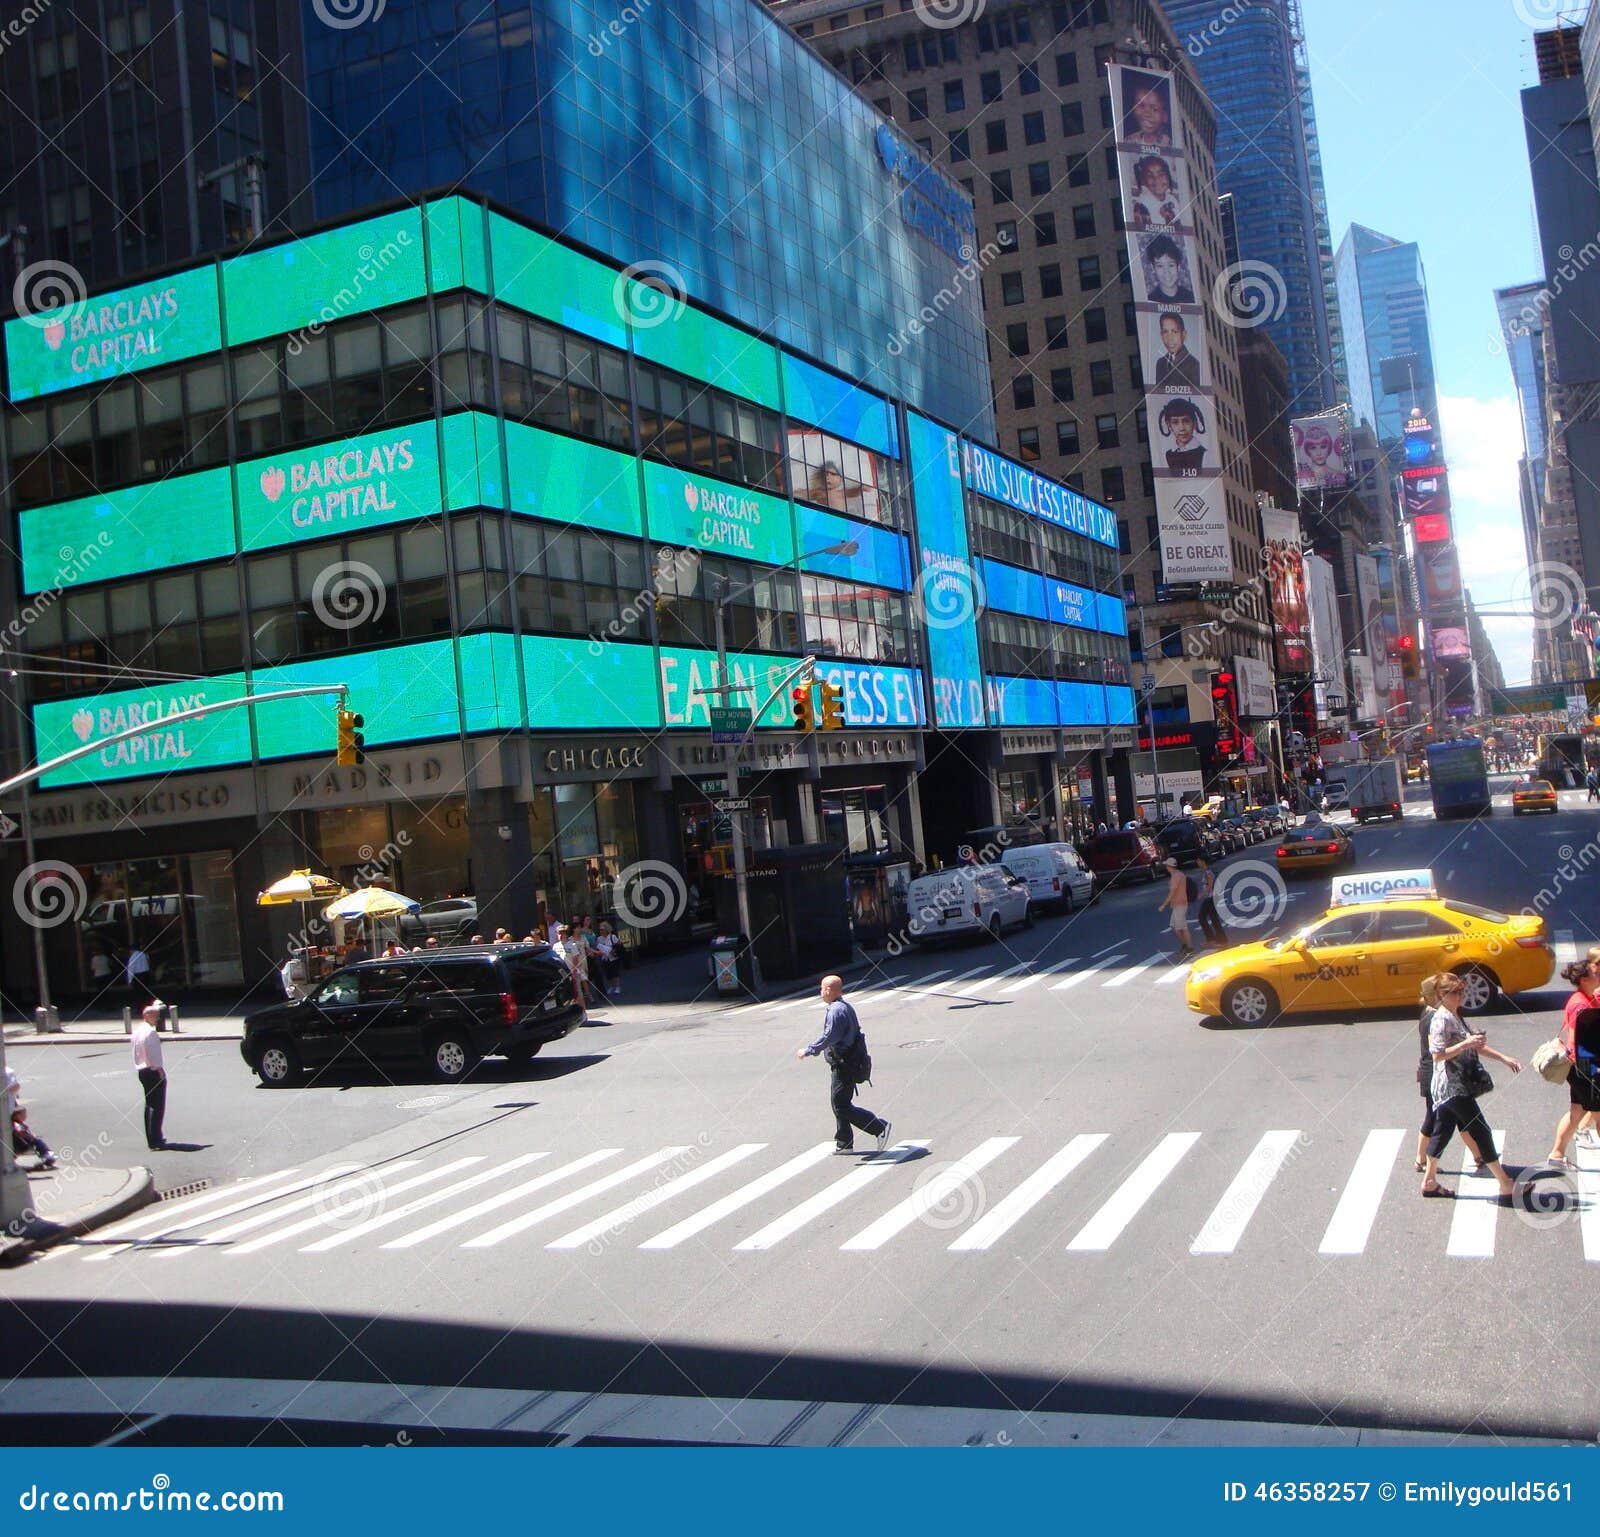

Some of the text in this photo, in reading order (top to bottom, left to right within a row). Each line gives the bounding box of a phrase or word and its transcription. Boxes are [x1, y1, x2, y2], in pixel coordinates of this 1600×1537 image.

[1145, 224, 1176, 234] ASHANTI
[70, 287, 179, 342] BARCLAYS
[1157, 303, 1182, 313] MARIO
[71, 327, 162, 374] CAPITAL
[1165, 384, 1192, 395] DENZEL
[1407, 417, 1428, 428] 2010
[290, 439, 414, 494] BARCLAYS
[1182, 468, 1197, 477] J-LO
[292, 480, 397, 527] CAPITAL
[700, 487, 761, 525] BARCLAYS
[999, 460, 1061, 521] SUCCESS
[702, 517, 755, 550] CAPITAL
[1166, 545, 1229, 560] BE GREAT.
[966, 679, 1006, 725] DAY
[1142, 682, 1154, 691] 30
[99, 692, 206, 735] BARCLAYS
[101, 730, 193, 768] CAPITAL
[293, 757, 441, 797] MADRID
[81, 784, 230, 822] FRANCISCO
[1341, 877, 1420, 896] CHICAGO
